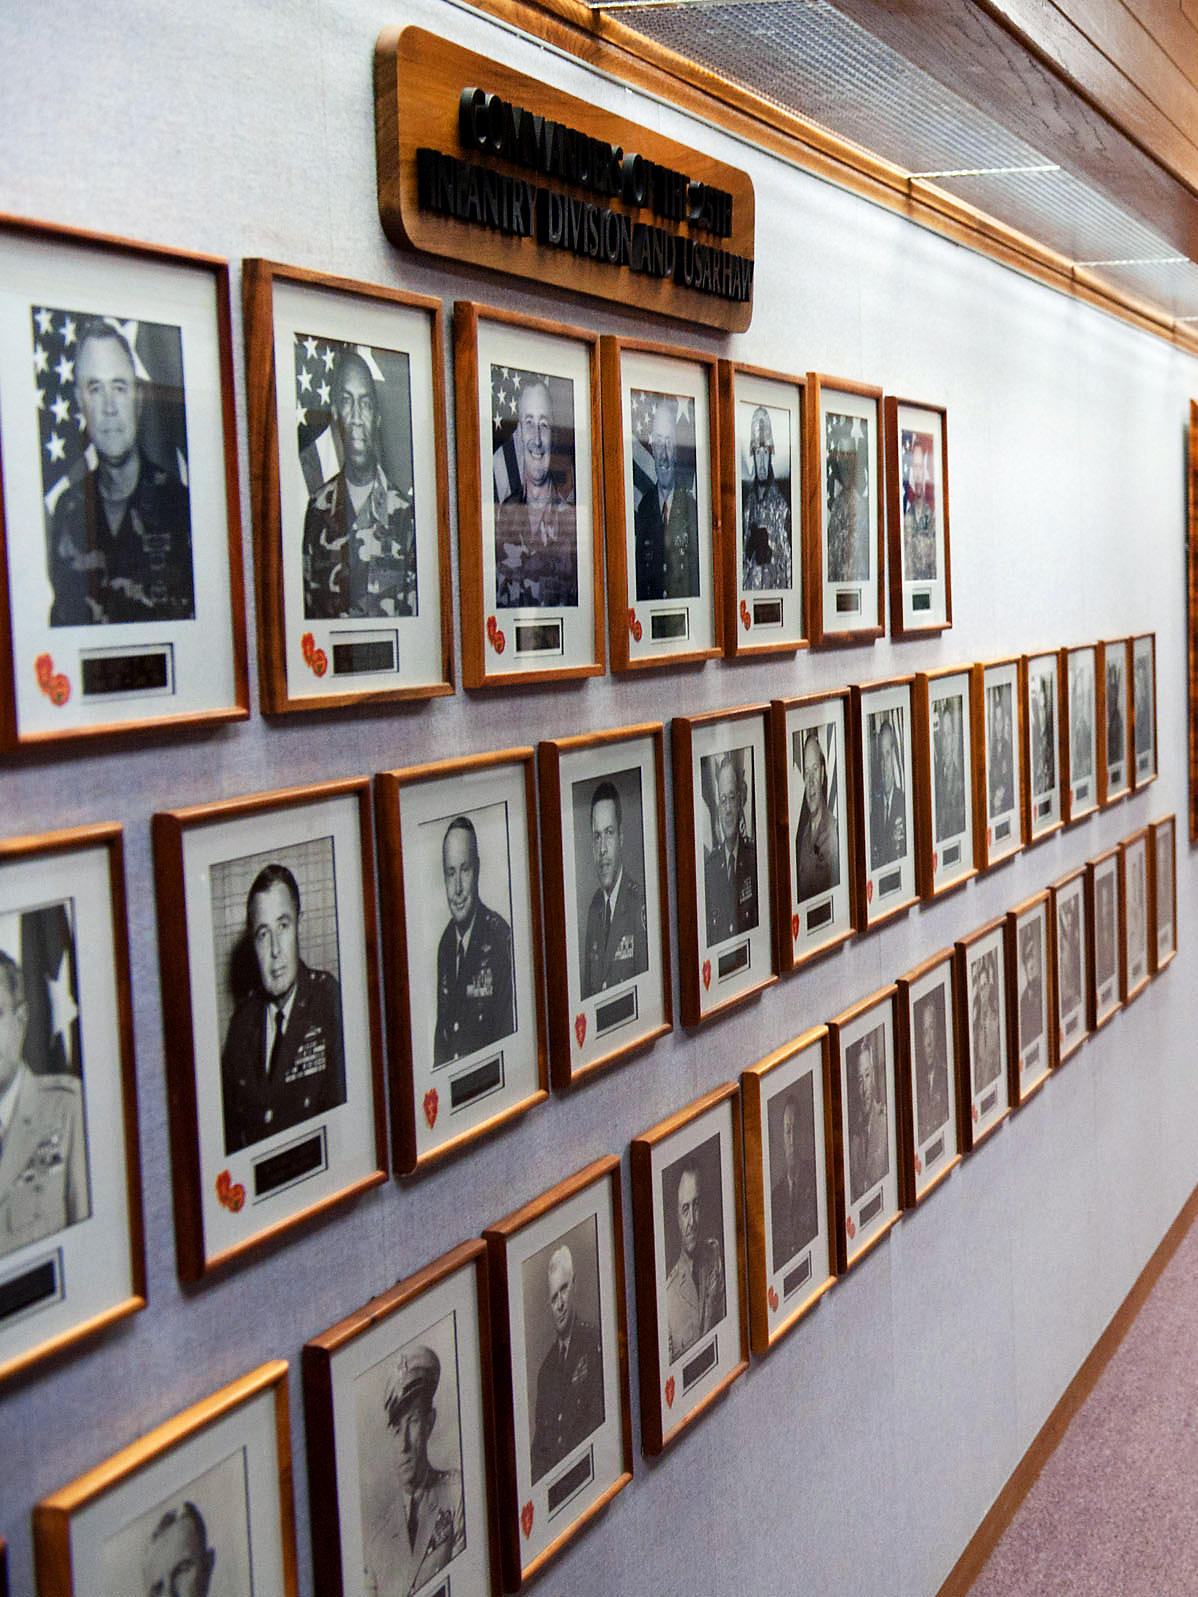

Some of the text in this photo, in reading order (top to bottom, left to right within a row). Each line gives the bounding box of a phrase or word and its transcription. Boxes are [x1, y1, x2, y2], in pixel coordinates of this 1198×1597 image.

[418, 147, 537, 237] INFANTRY
[537, 188, 634, 266] DIVISION
[631, 223, 677, 279] AND
